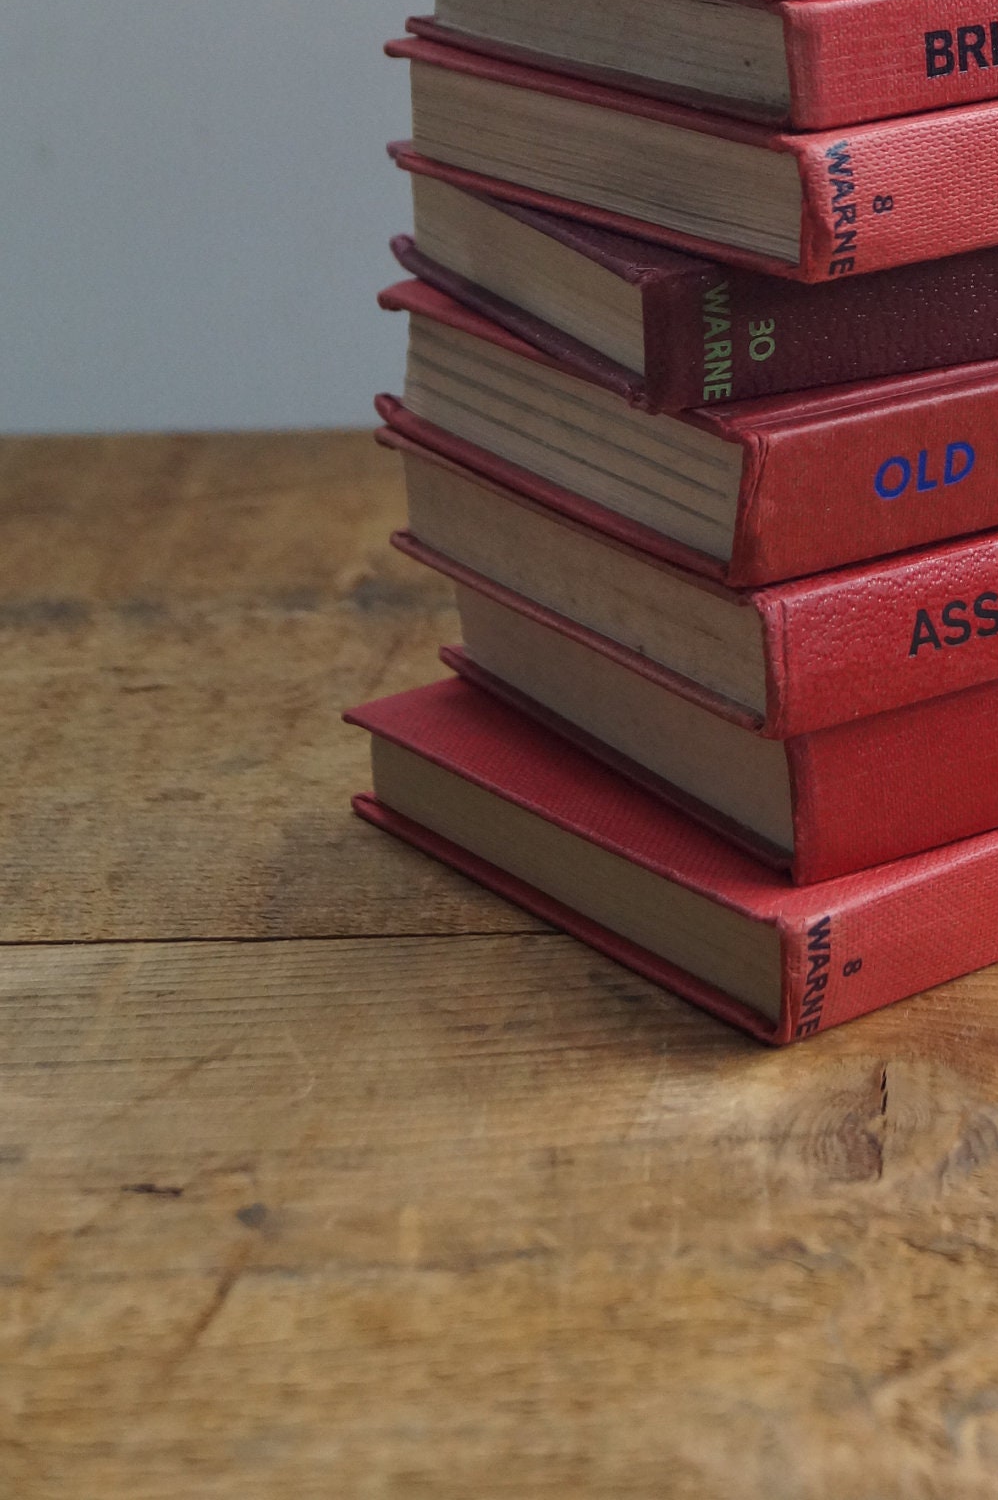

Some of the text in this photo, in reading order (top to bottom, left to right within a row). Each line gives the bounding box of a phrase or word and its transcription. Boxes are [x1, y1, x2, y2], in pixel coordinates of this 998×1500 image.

[824, 140, 859, 277] WARNE
[872, 194, 895, 215] 8
[702, 280, 734, 402] WARNE
[749, 317, 777, 363] 30
[873, 440, 976, 500] OLD
[795, 915, 831, 1037] WARNE
[842, 956, 863, 978] 8
